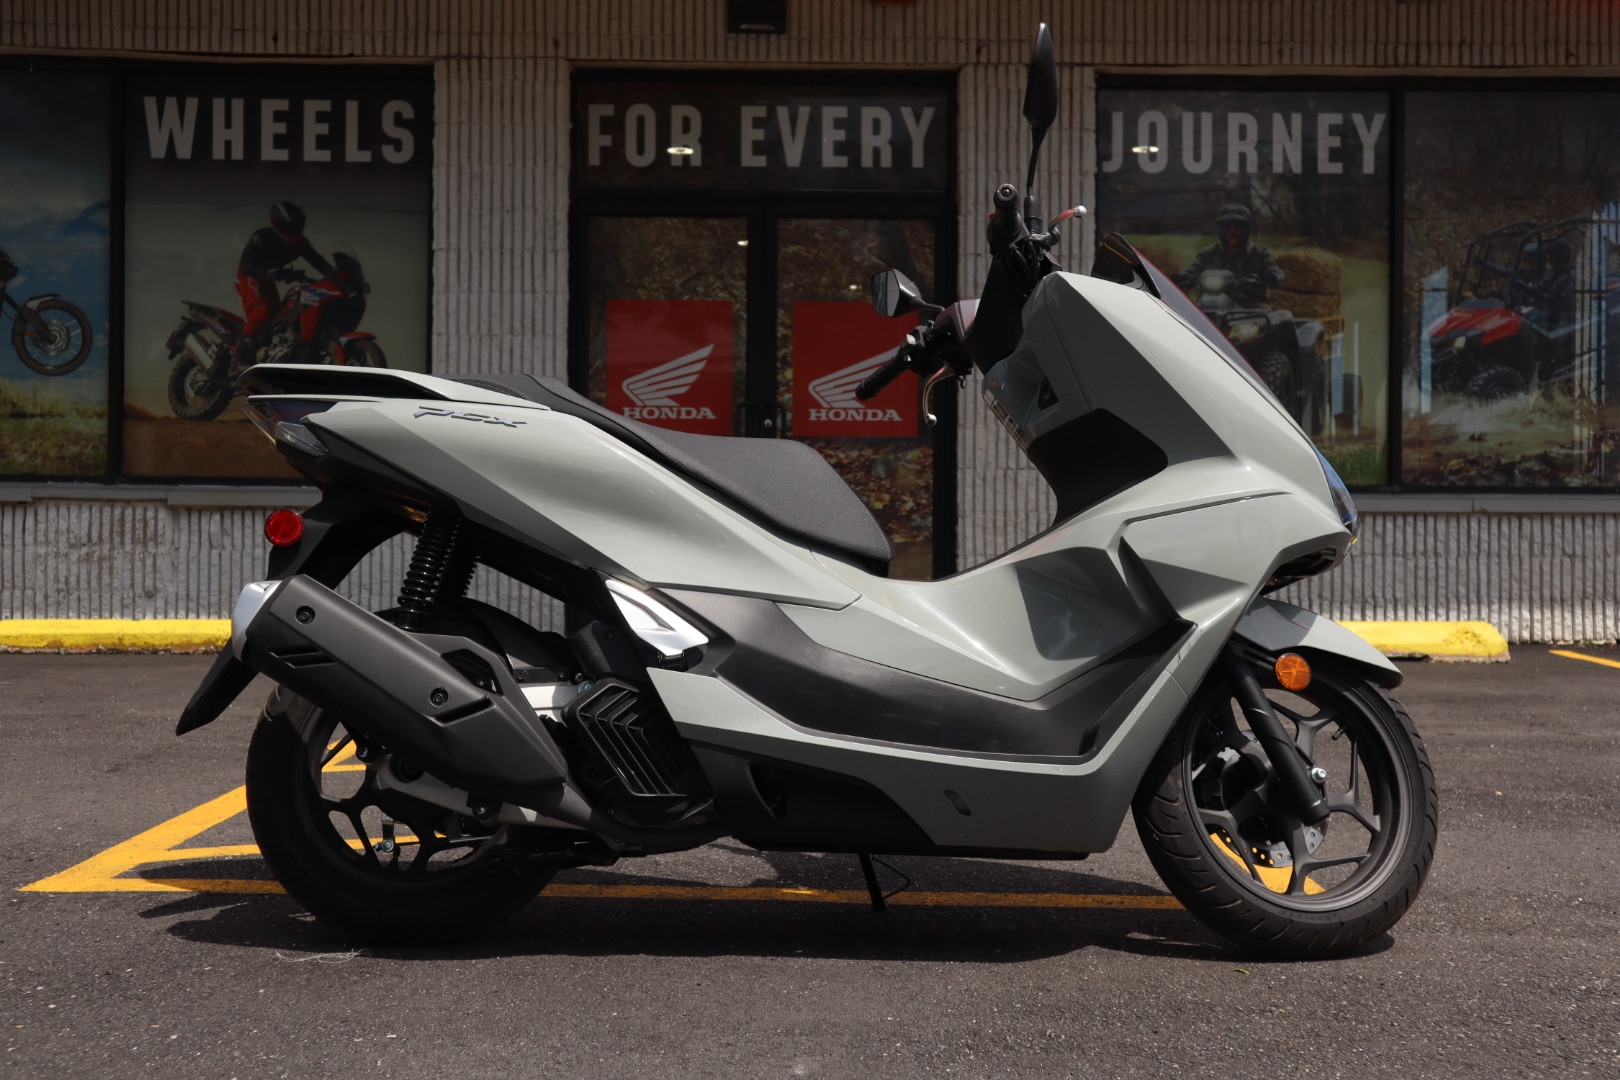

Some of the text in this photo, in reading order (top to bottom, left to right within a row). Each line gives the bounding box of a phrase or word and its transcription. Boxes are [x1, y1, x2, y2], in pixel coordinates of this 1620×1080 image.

[143, 96, 415, 164] WHEELS
[588, 104, 935, 168] FOR EVERY
[1102, 110, 1386, 174] JOURNEY
[414, 406, 528, 428] PCX
[622, 407, 716, 420] HONDA
[808, 408, 902, 421] HONDA
